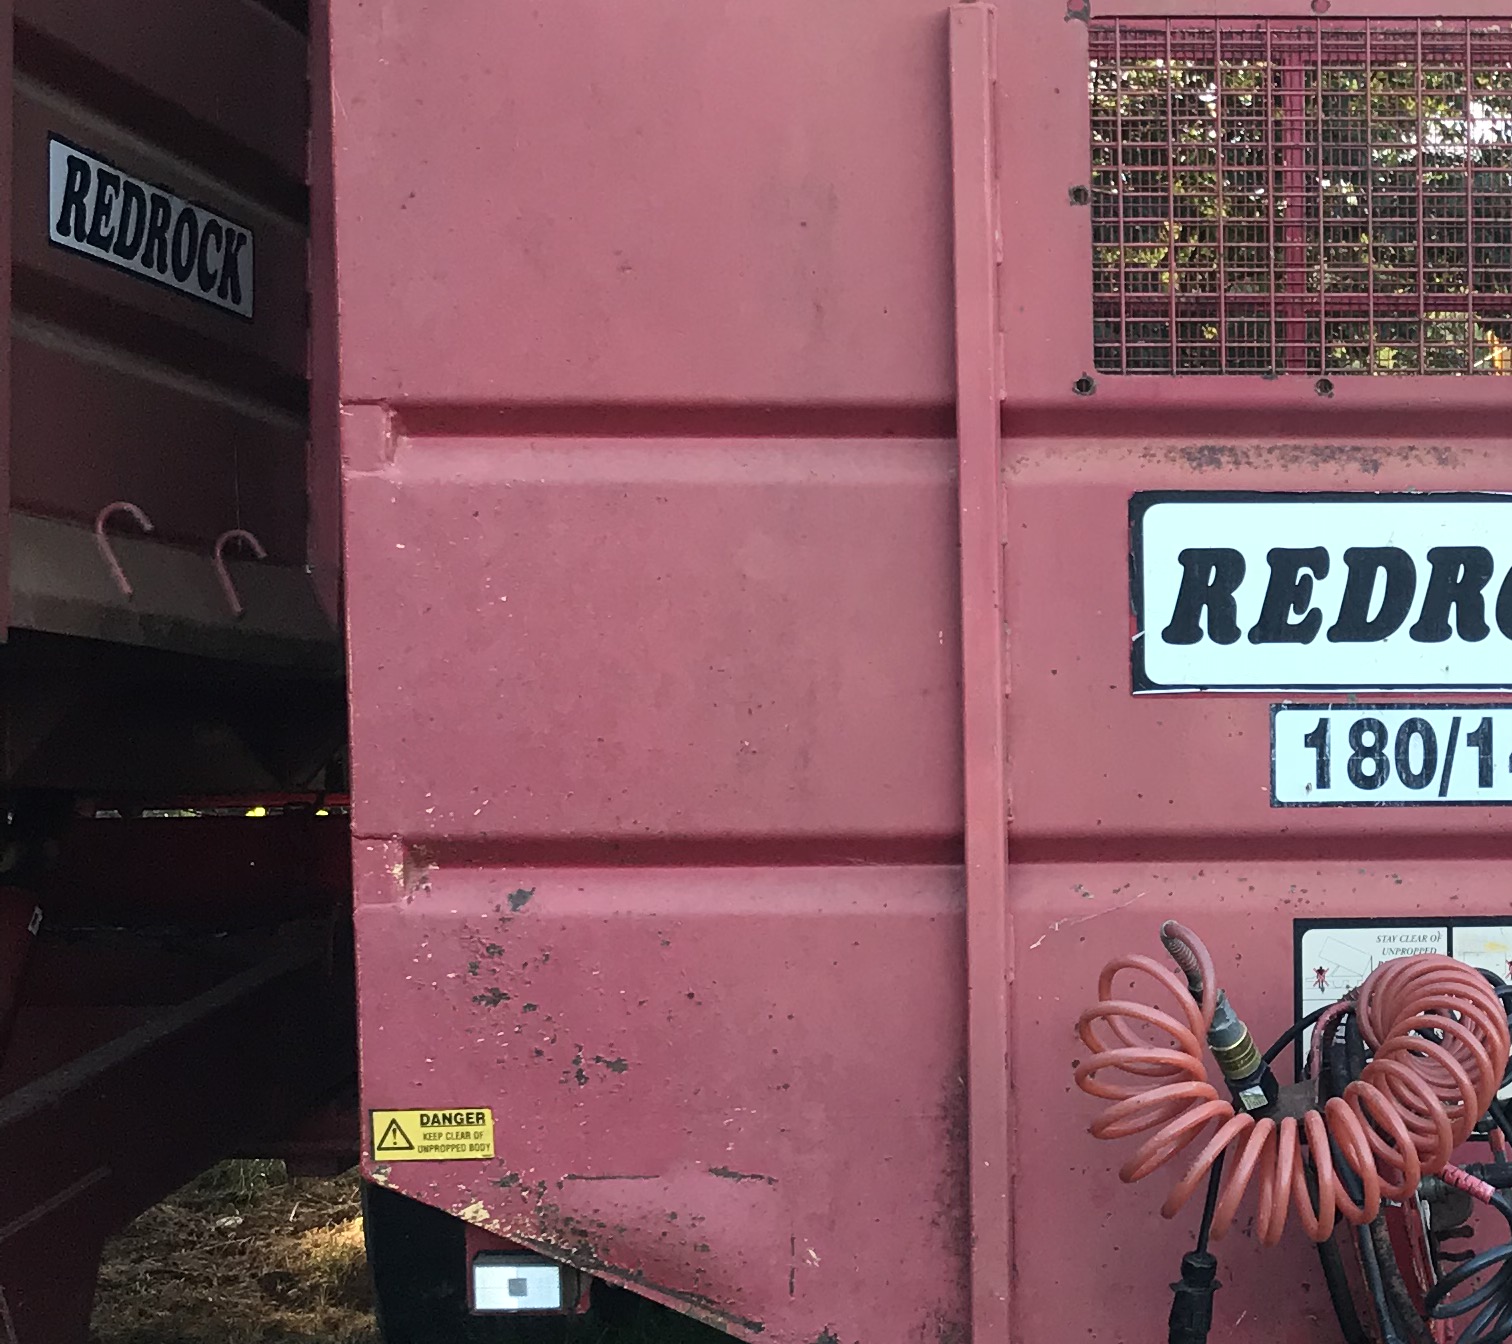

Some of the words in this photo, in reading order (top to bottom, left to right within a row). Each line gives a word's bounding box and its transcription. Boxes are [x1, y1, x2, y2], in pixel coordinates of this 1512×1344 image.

[56, 154, 247, 305] REDROCK
[1376, 935, 1398, 943] STAY
[1399, 935, 1428, 943] CLEAR
[1382, 947, 1437, 955] UNPROPPED
[419, 1112, 486, 1126] DANGER
[423, 1132, 443, 1141] KEEP
[445, 1131, 471, 1141] CLEAR
[473, 1131, 484, 1140] OF
[417, 1144, 467, 1153] UNPROPPED
[469, 1143, 491, 1152] BODY
